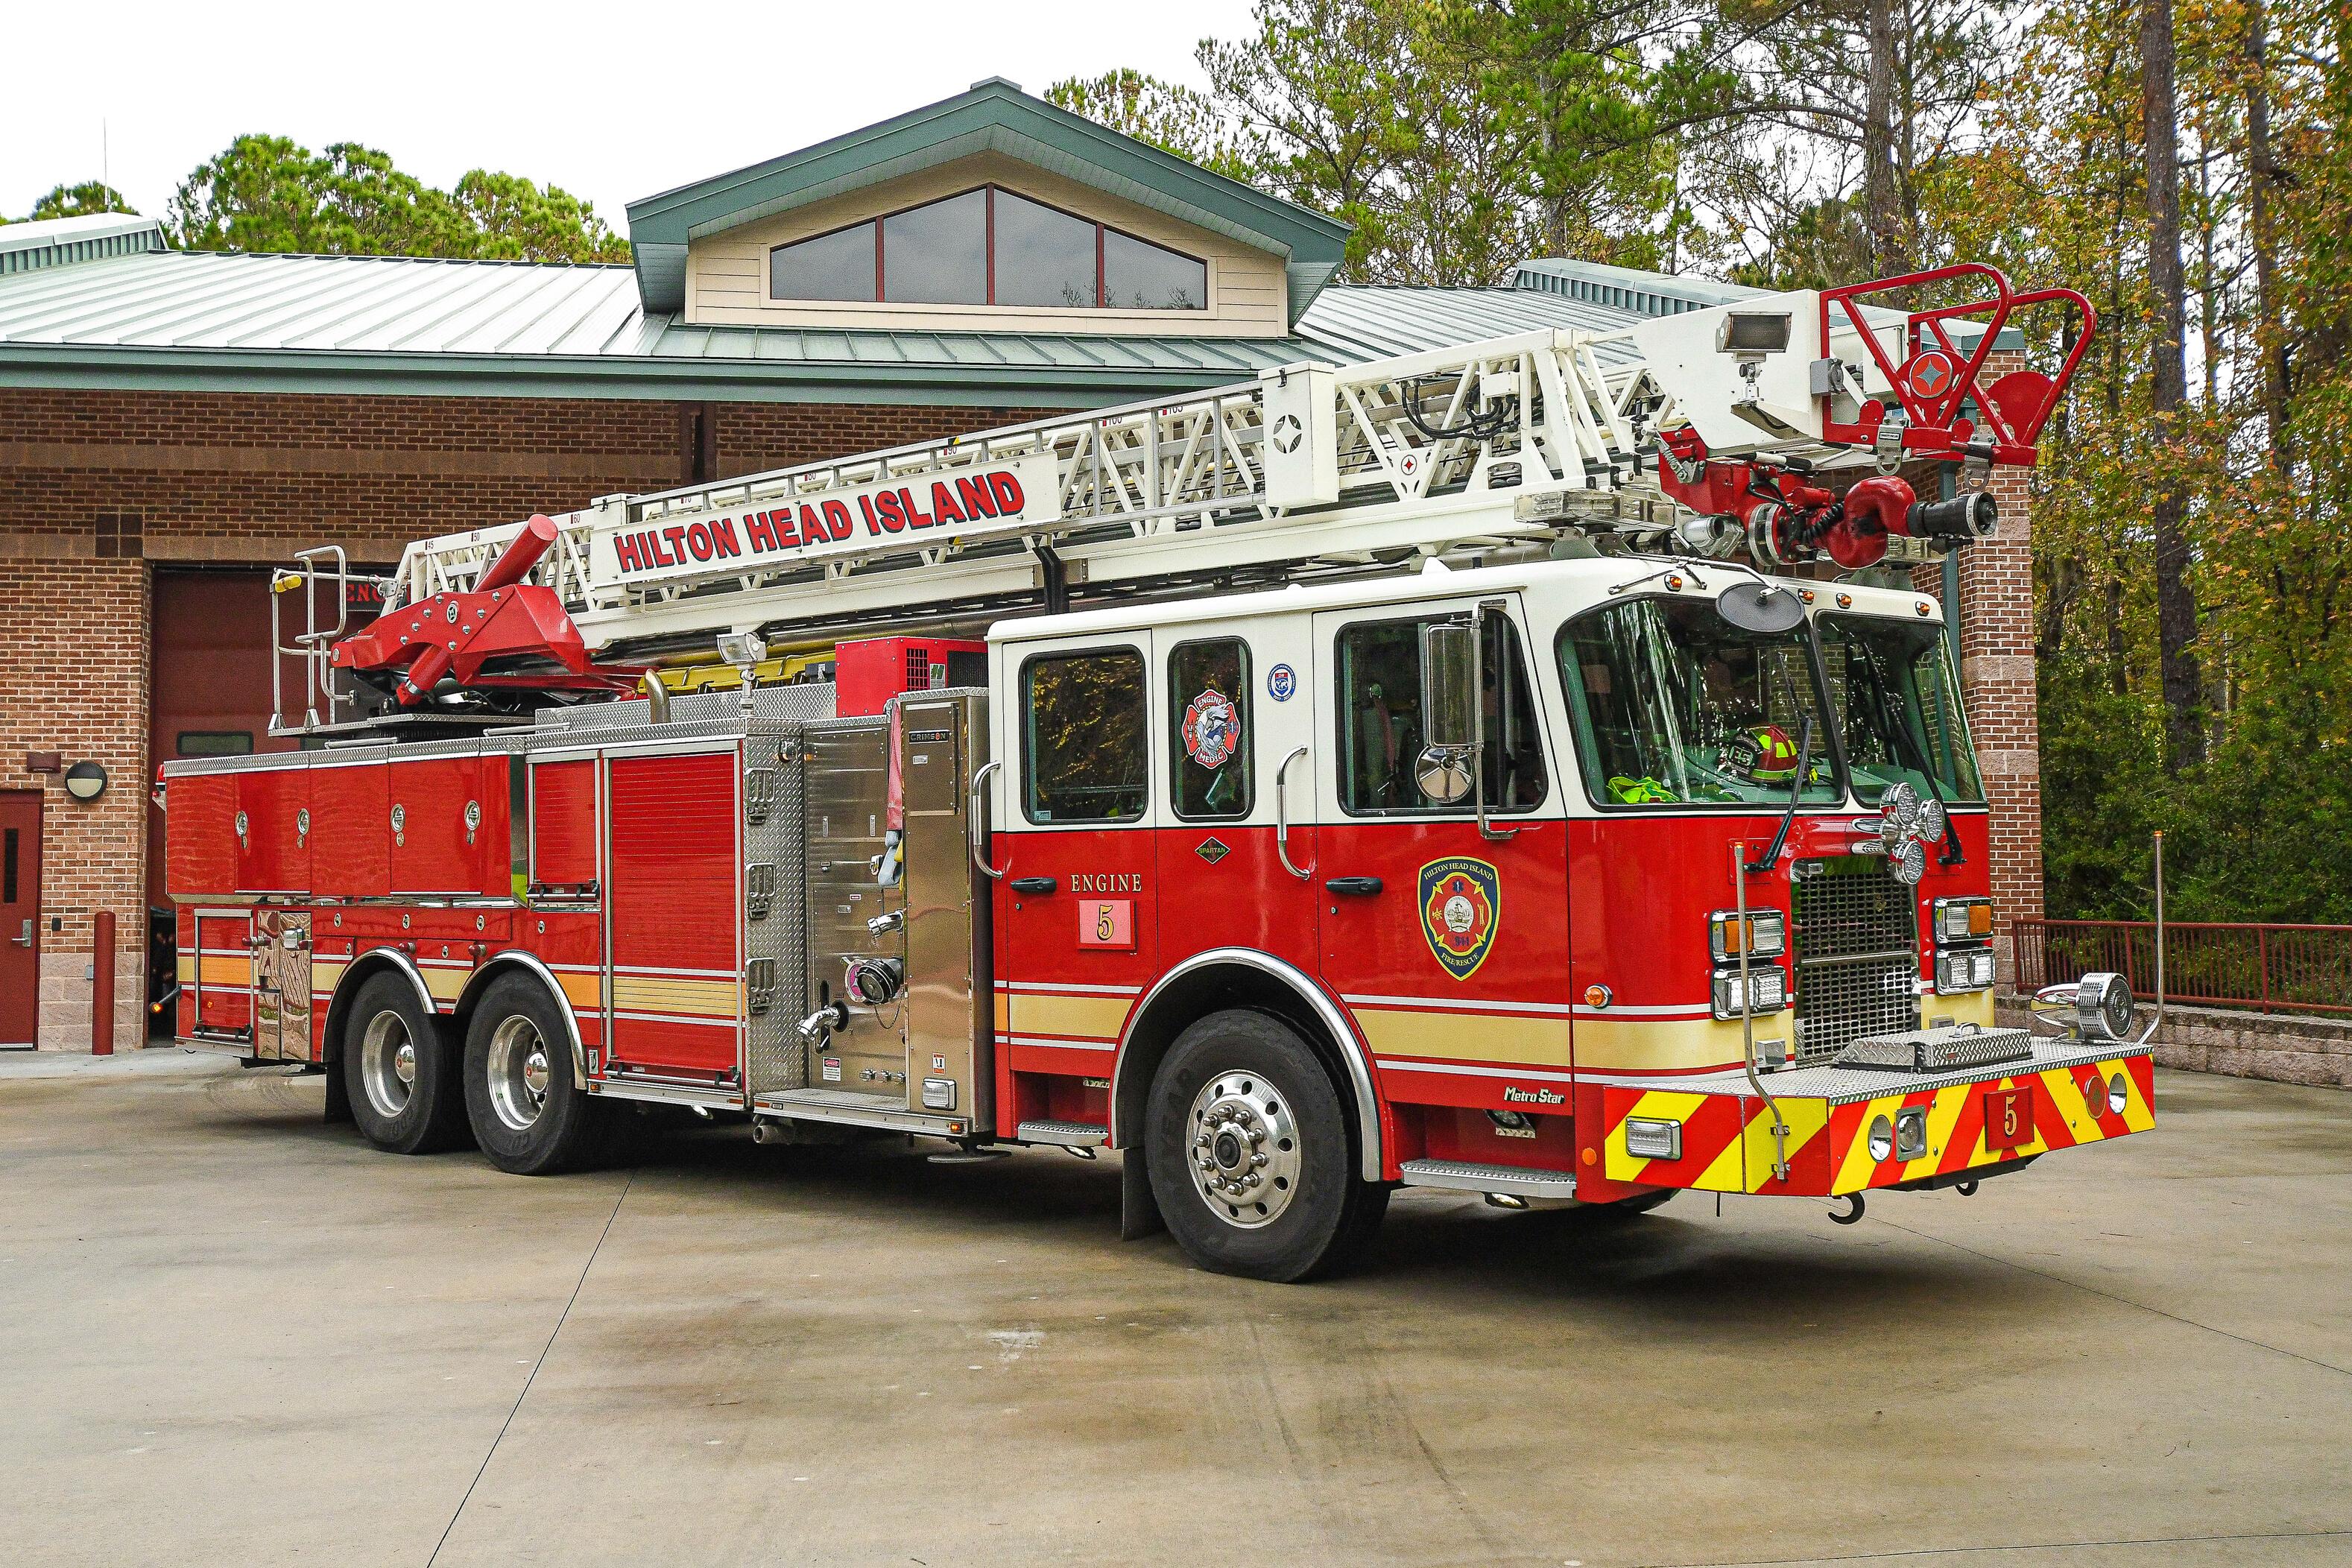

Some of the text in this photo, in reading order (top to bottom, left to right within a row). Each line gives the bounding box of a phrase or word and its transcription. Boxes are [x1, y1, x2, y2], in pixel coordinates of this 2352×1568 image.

[573, 513, 581, 523] 60
[614, 470, 1026, 573] HILTON HEAD ISLAND
[472, 532, 480, 542] 50
[428, 541, 434, 550] 45
[1198, 695, 1223, 708] ENGINE
[910, 733, 946, 741] CRIMSON
[1199, 752, 1224, 763] MEDIC
[1424, 863, 1448, 879] HILTON
[1470, 864, 1493, 880] ISLAND
[1071, 873, 1142, 893] ENGINE
[1097, 904, 1114, 941] 5
[1504, 1086, 1565, 1104] Metro Star
[2005, 1095, 2017, 1137] 5
